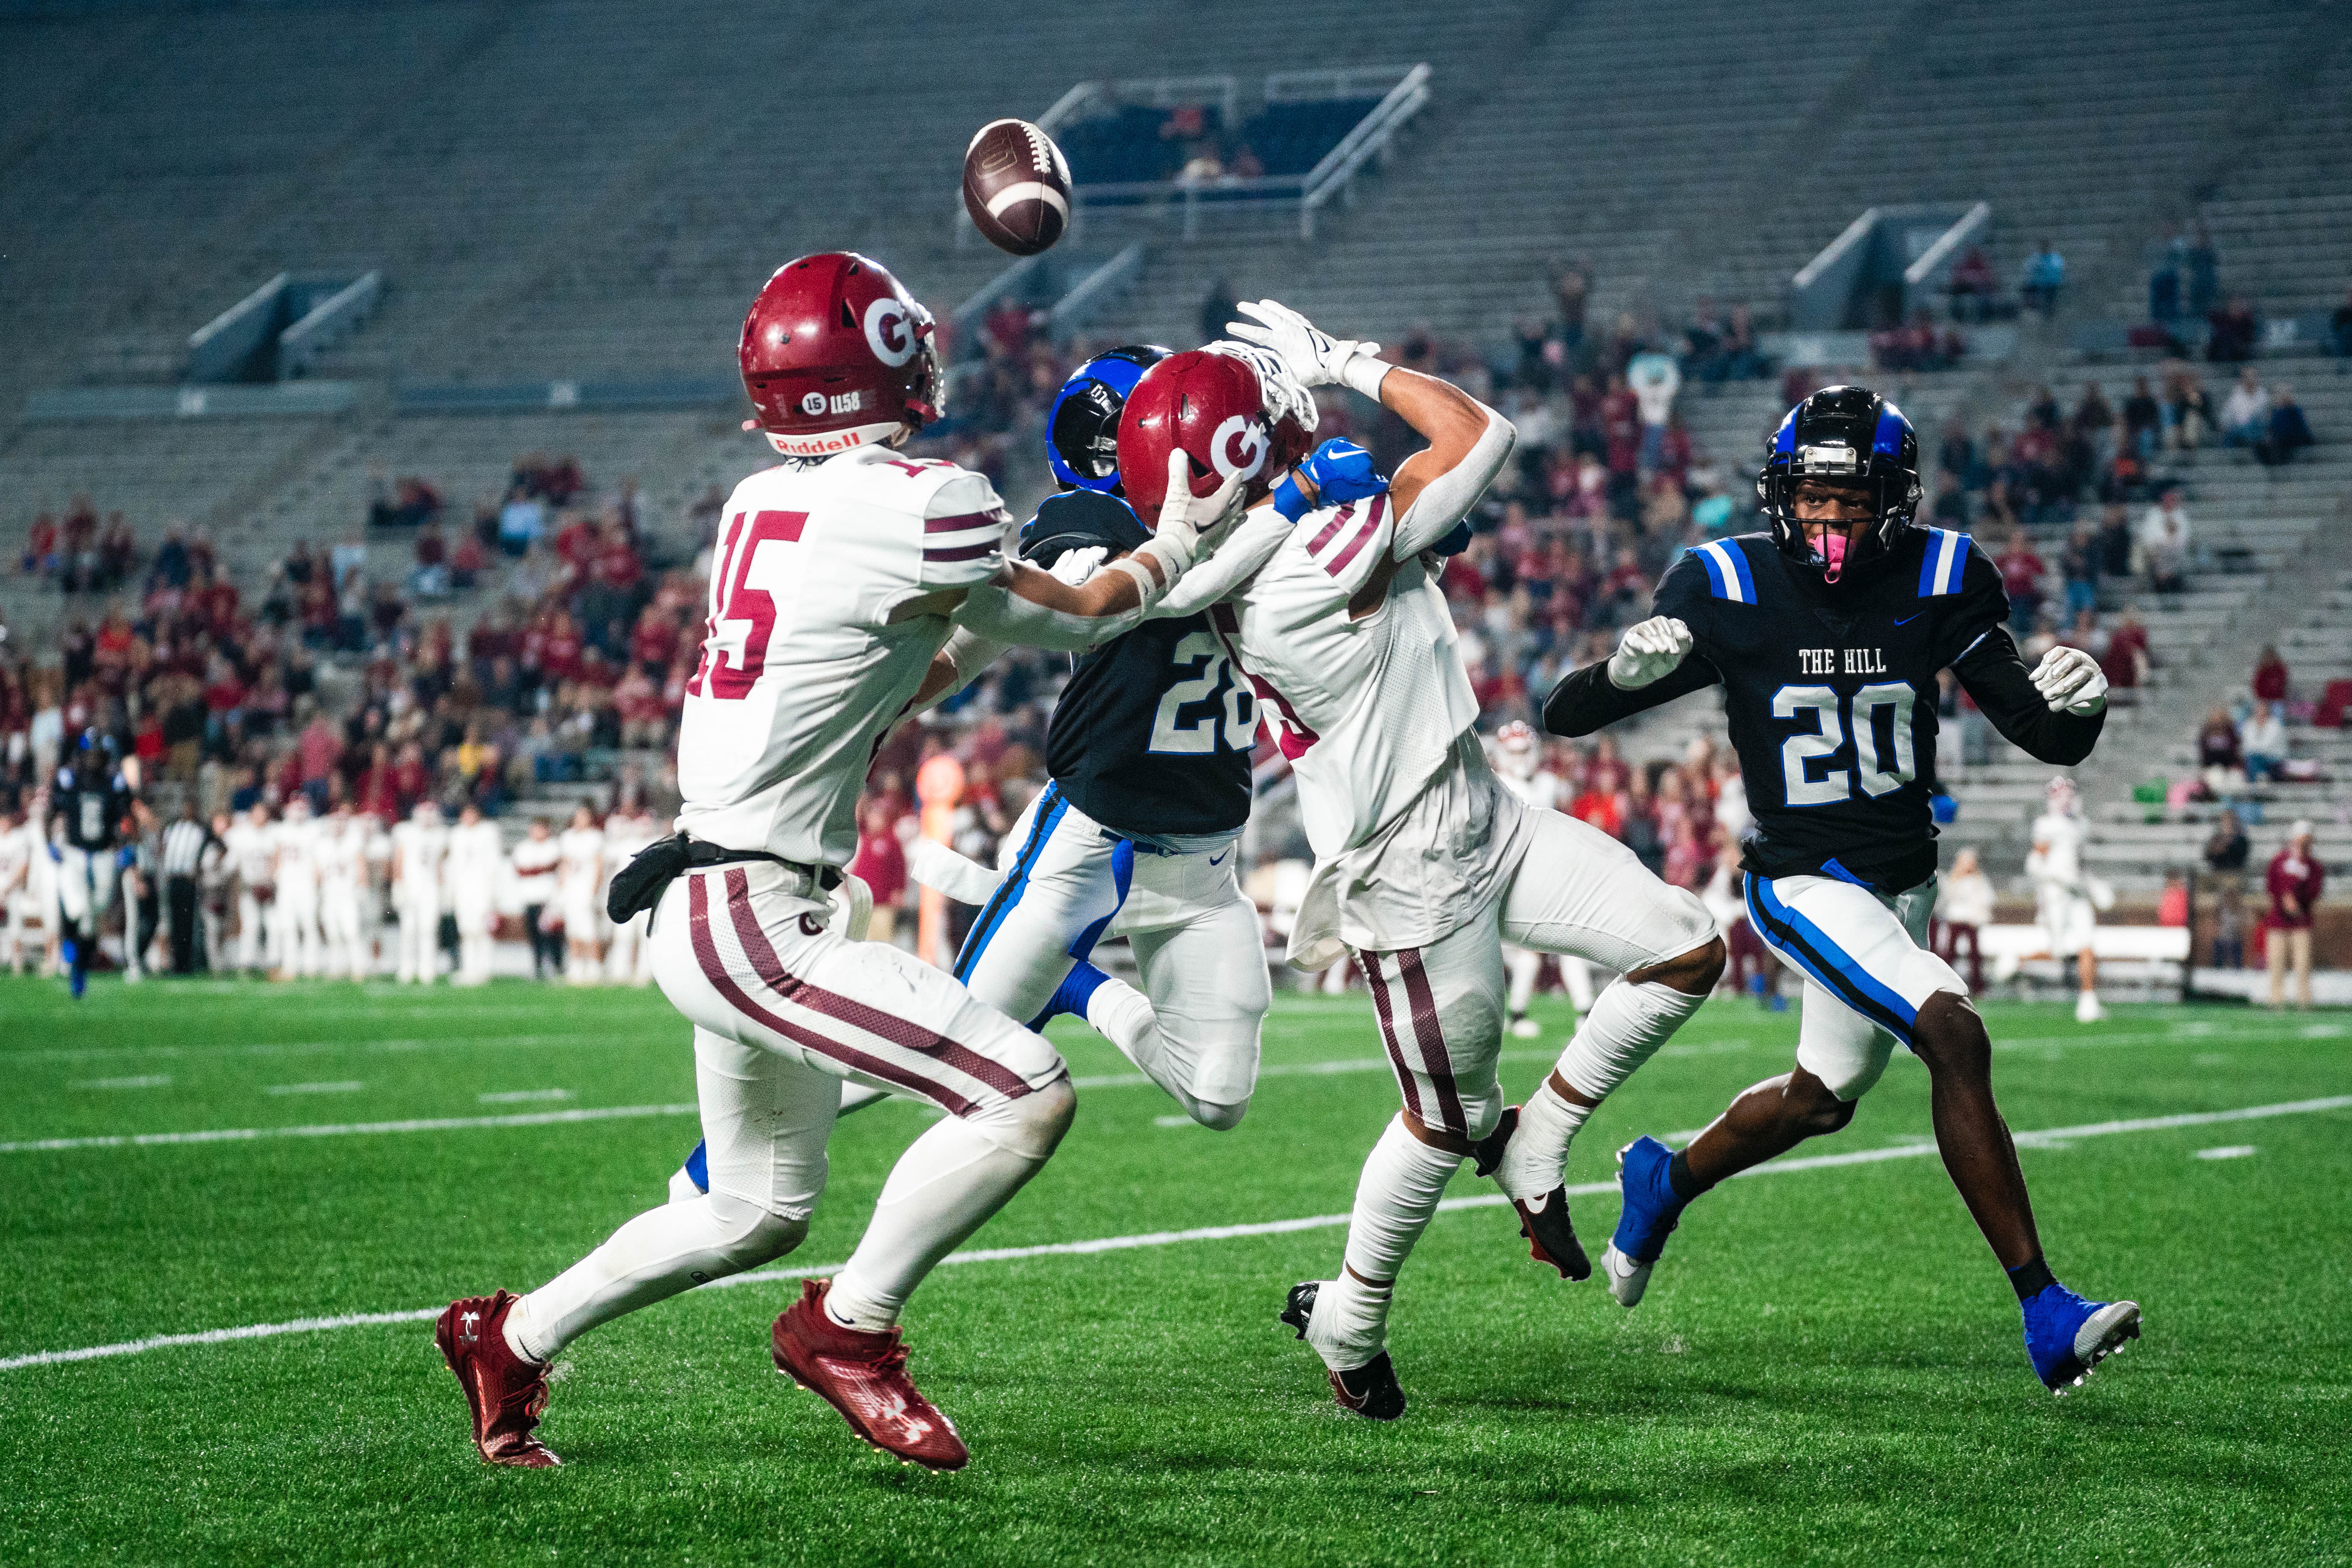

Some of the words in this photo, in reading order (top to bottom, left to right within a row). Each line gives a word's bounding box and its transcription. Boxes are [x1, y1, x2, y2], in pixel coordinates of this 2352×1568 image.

[863, 298, 917, 368] G
[806, 397, 821, 410] 15
[775, 432, 860, 454] Riddell
[1210, 415, 1271, 481] G
[685, 510, 809, 700] 15
[1799, 649, 1835, 674] THE
[1844, 648, 1886, 674] HILL
[1770, 679, 1917, 807] 20
